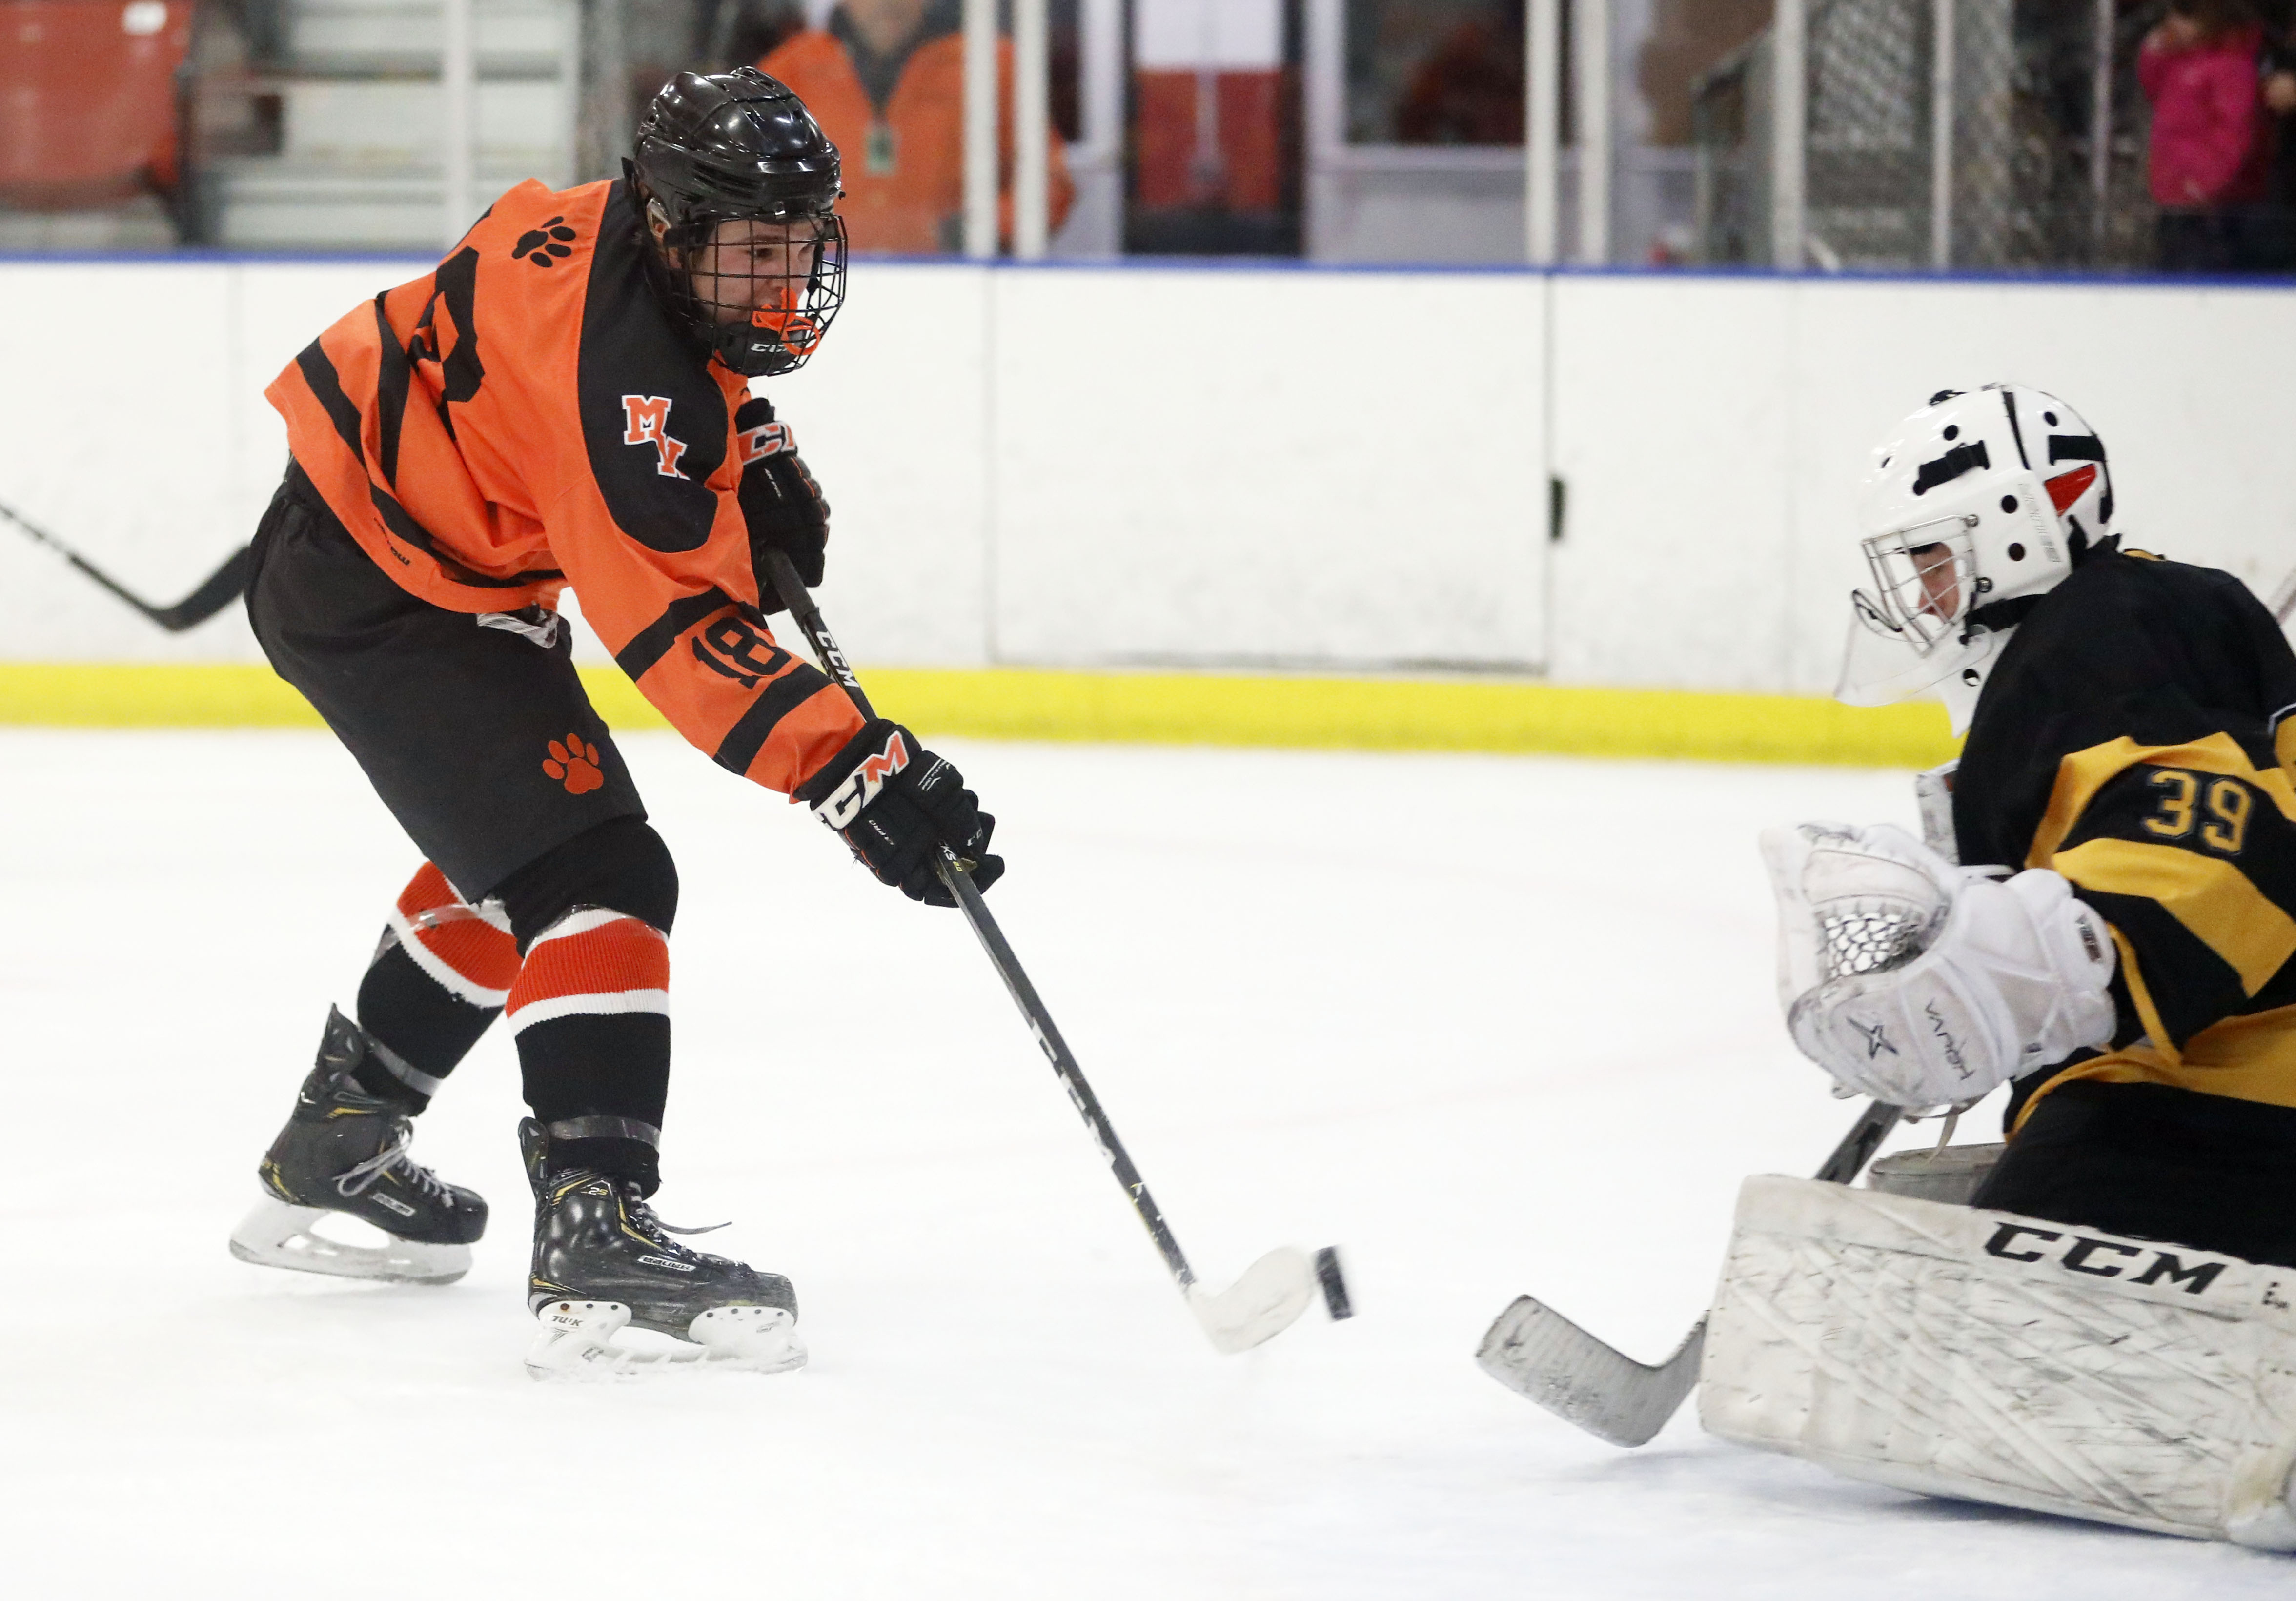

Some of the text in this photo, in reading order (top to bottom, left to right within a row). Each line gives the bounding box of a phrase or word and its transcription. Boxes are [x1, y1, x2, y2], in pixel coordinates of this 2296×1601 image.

[751, 343, 788, 352] CC
[692, 617, 792, 690] 18
[816, 631, 860, 688] CCM
[2141, 769, 2253, 856] 39
[1982, 1222, 2228, 1295] CCM
